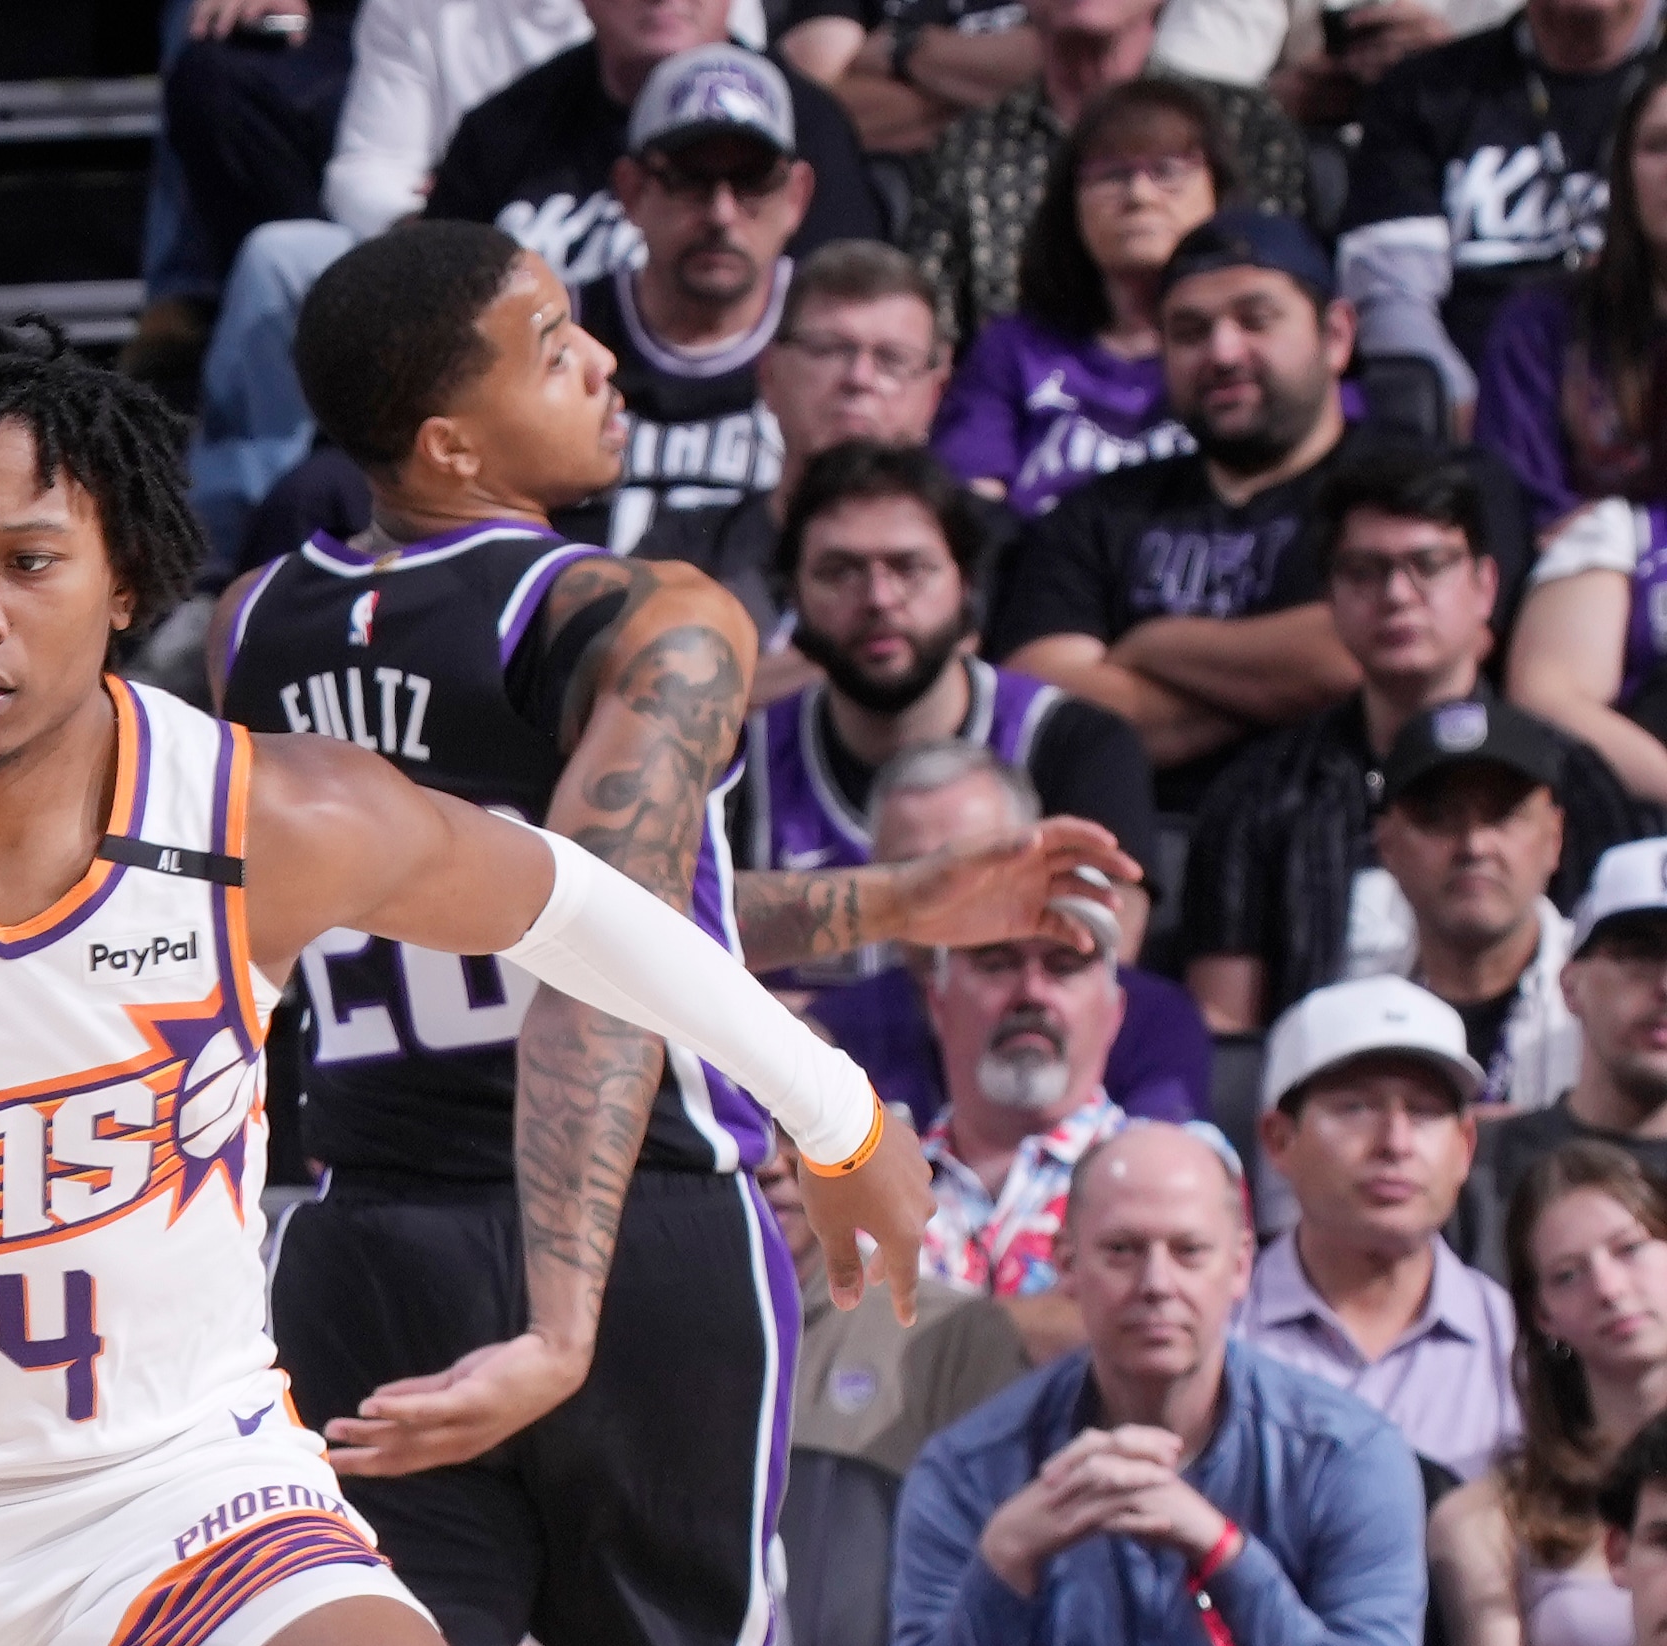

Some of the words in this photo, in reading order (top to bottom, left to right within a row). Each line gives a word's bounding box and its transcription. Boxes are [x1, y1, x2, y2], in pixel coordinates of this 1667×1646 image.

[279, 666, 432, 762] FULTZ
[157, 849, 183, 873] AL
[89, 931, 198, 976] PayPal
[173, 1484, 351, 1561] PHOENIX
